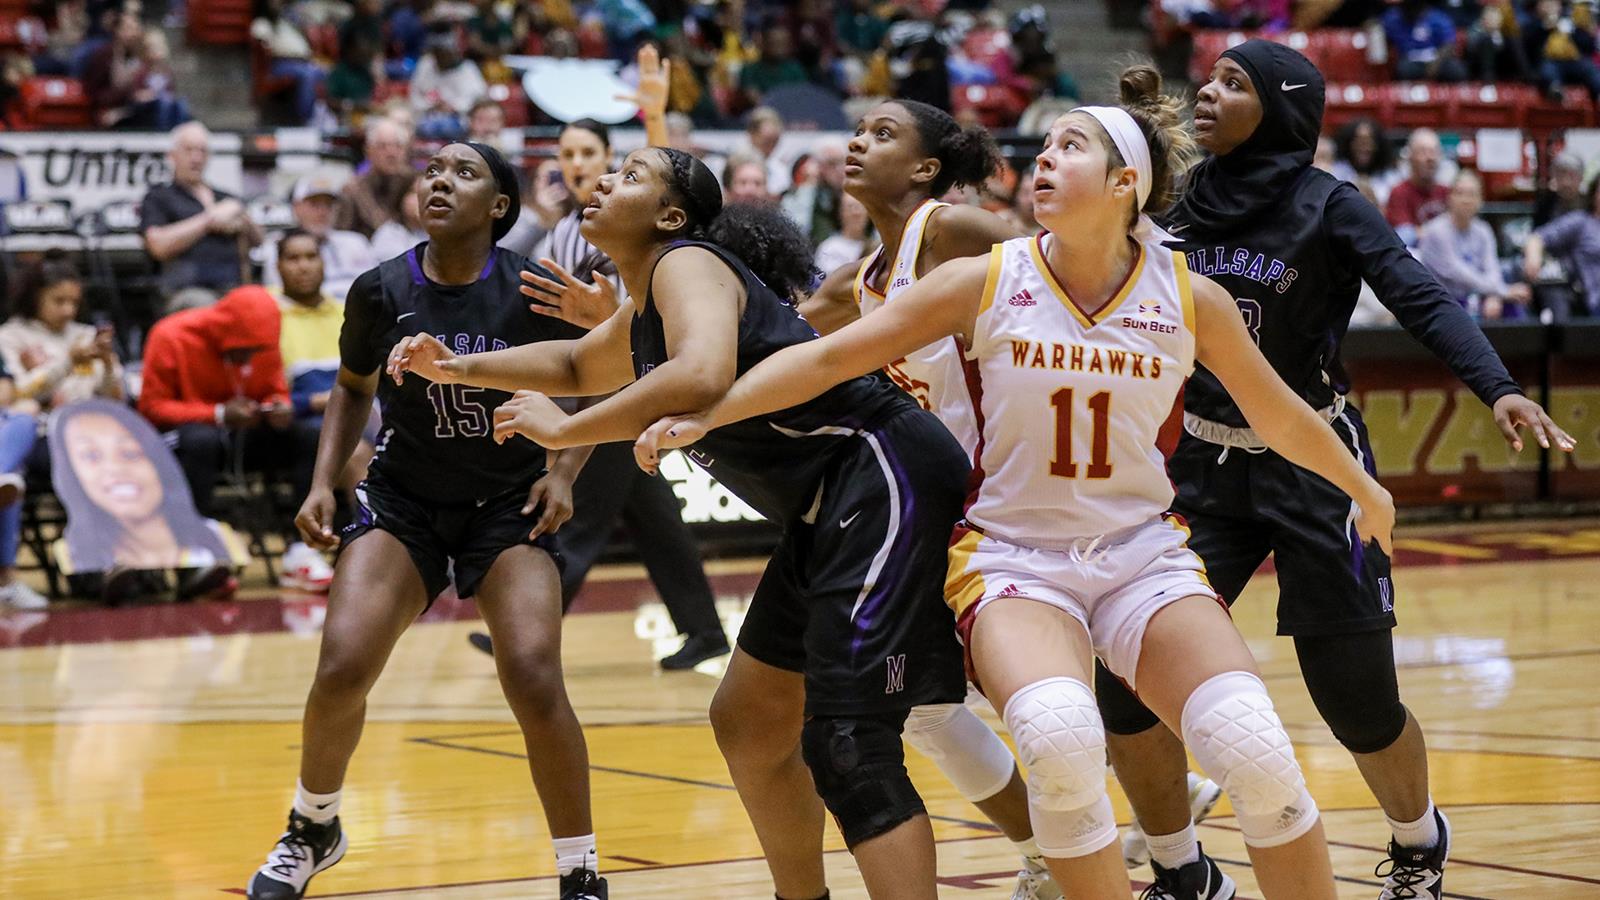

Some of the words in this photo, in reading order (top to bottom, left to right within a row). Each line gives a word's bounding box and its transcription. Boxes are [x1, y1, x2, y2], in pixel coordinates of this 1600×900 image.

[1186, 246, 1299, 294] ILLSAPS
[1122, 316, 1147, 331] SUN
[1150, 320, 1178, 335] BELT
[1010, 338, 1163, 379] WARHAWKS
[426, 382, 490, 438] 15
[1048, 385, 1113, 480] 11
[885, 653, 906, 694] M
